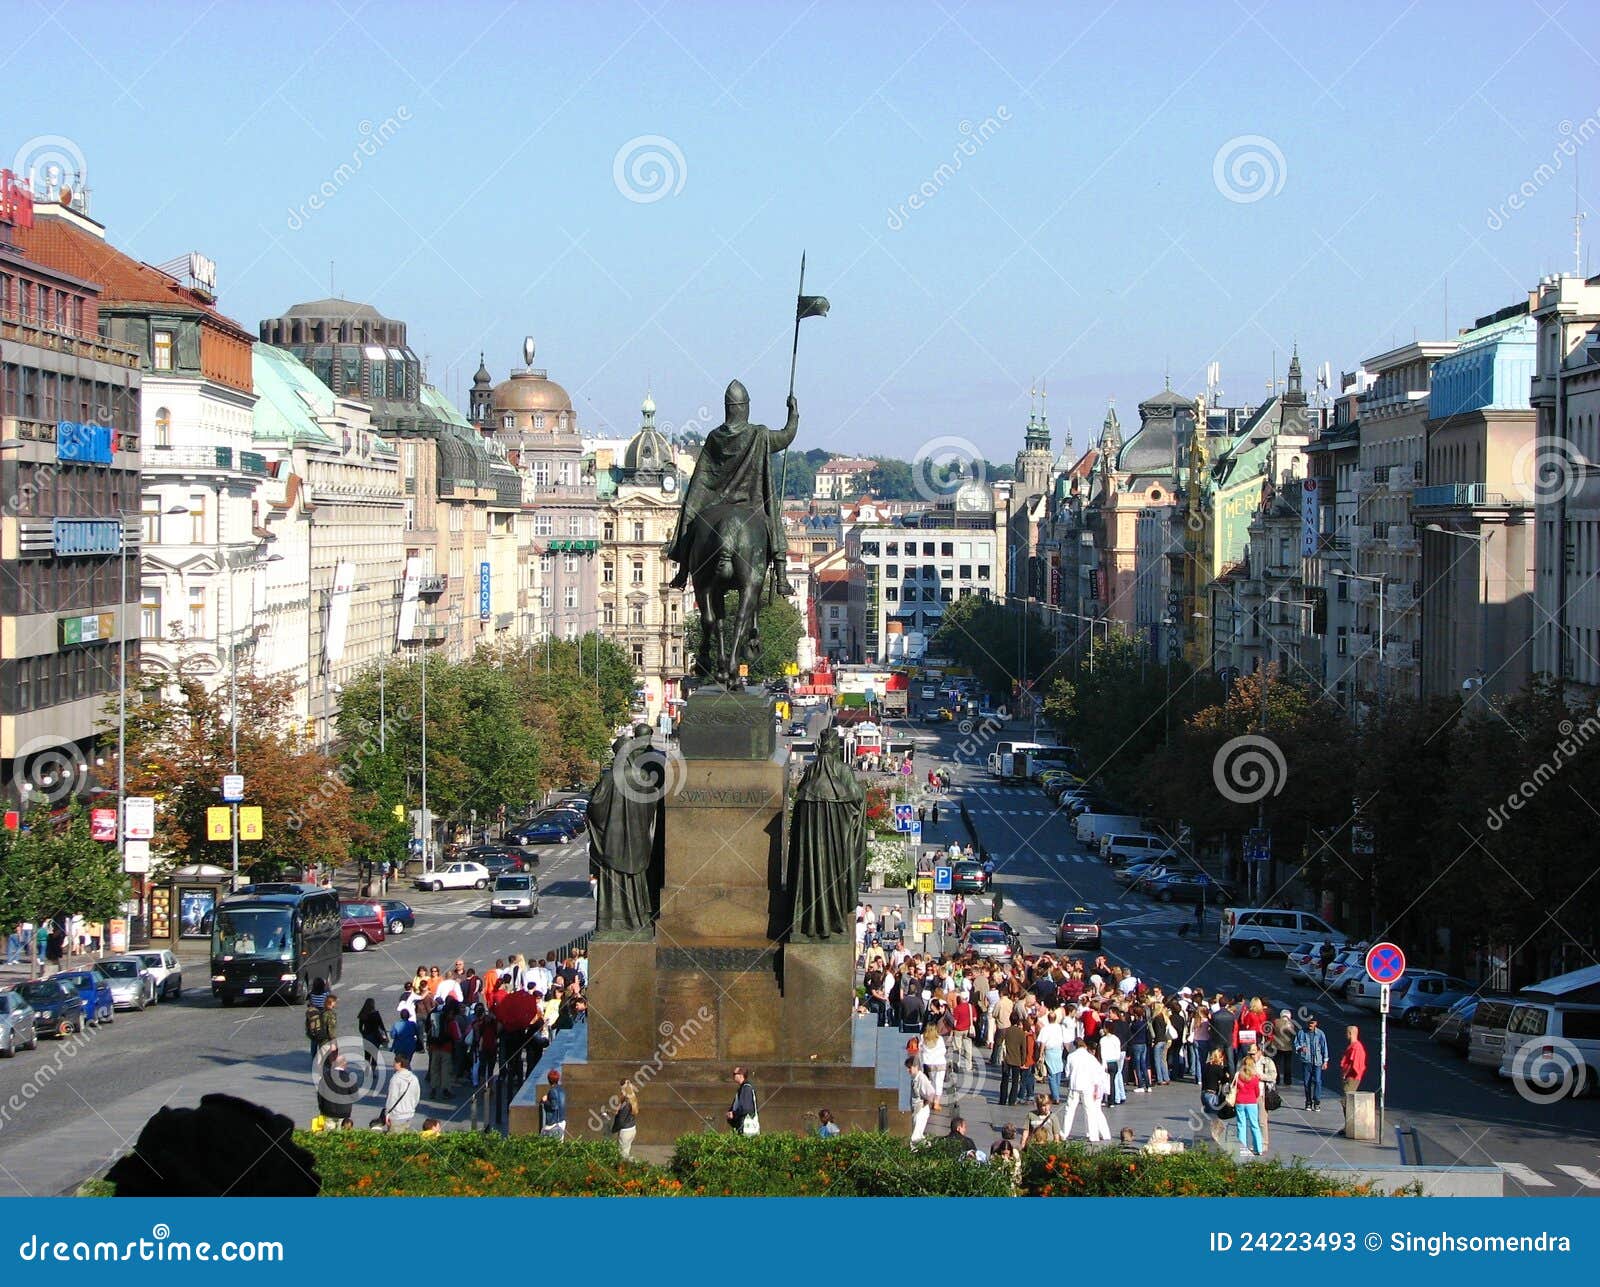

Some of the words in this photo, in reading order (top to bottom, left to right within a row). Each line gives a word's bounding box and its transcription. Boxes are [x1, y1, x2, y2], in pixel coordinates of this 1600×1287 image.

[1306, 497, 1314, 556] RAMADA
[481, 565, 489, 618] ROKOKO
[938, 869, 949, 883] P
